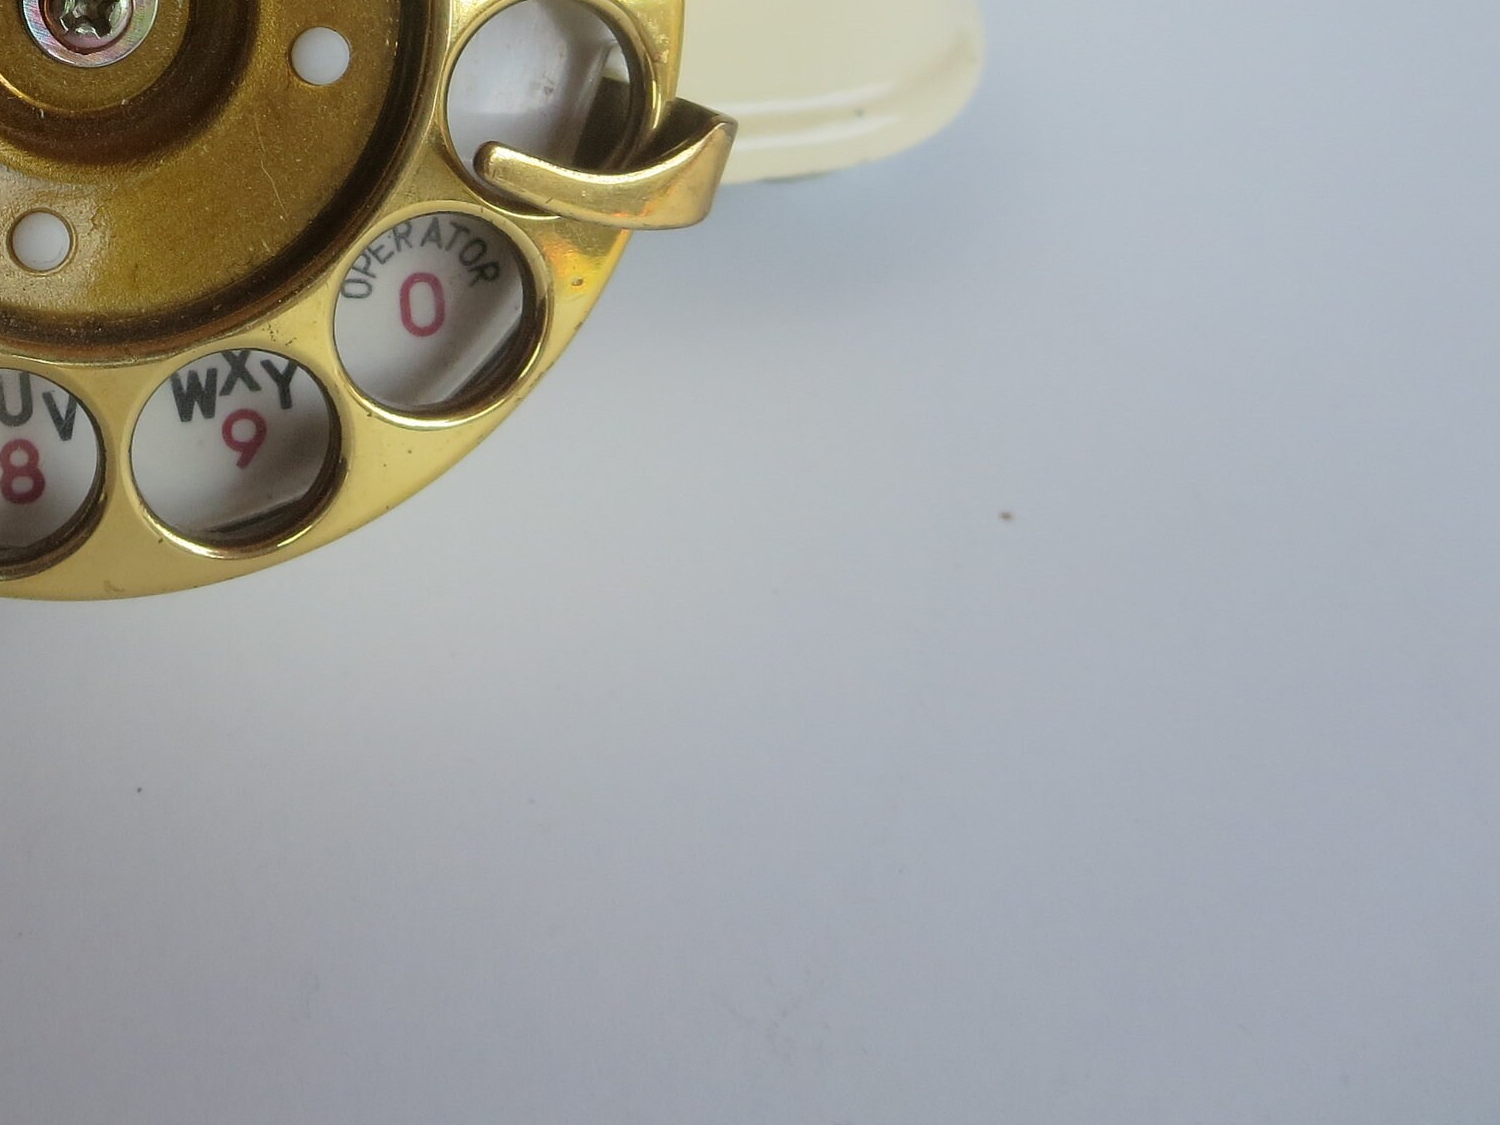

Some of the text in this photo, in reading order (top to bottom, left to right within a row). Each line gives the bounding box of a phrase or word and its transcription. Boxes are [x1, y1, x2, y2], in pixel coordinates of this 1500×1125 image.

[340, 217, 500, 300] OPERATOR
[400, 272, 445, 337] 0
[170, 349, 299, 422] WXY
[0, 438, 45, 505] 8
[221, 408, 267, 469] 9
